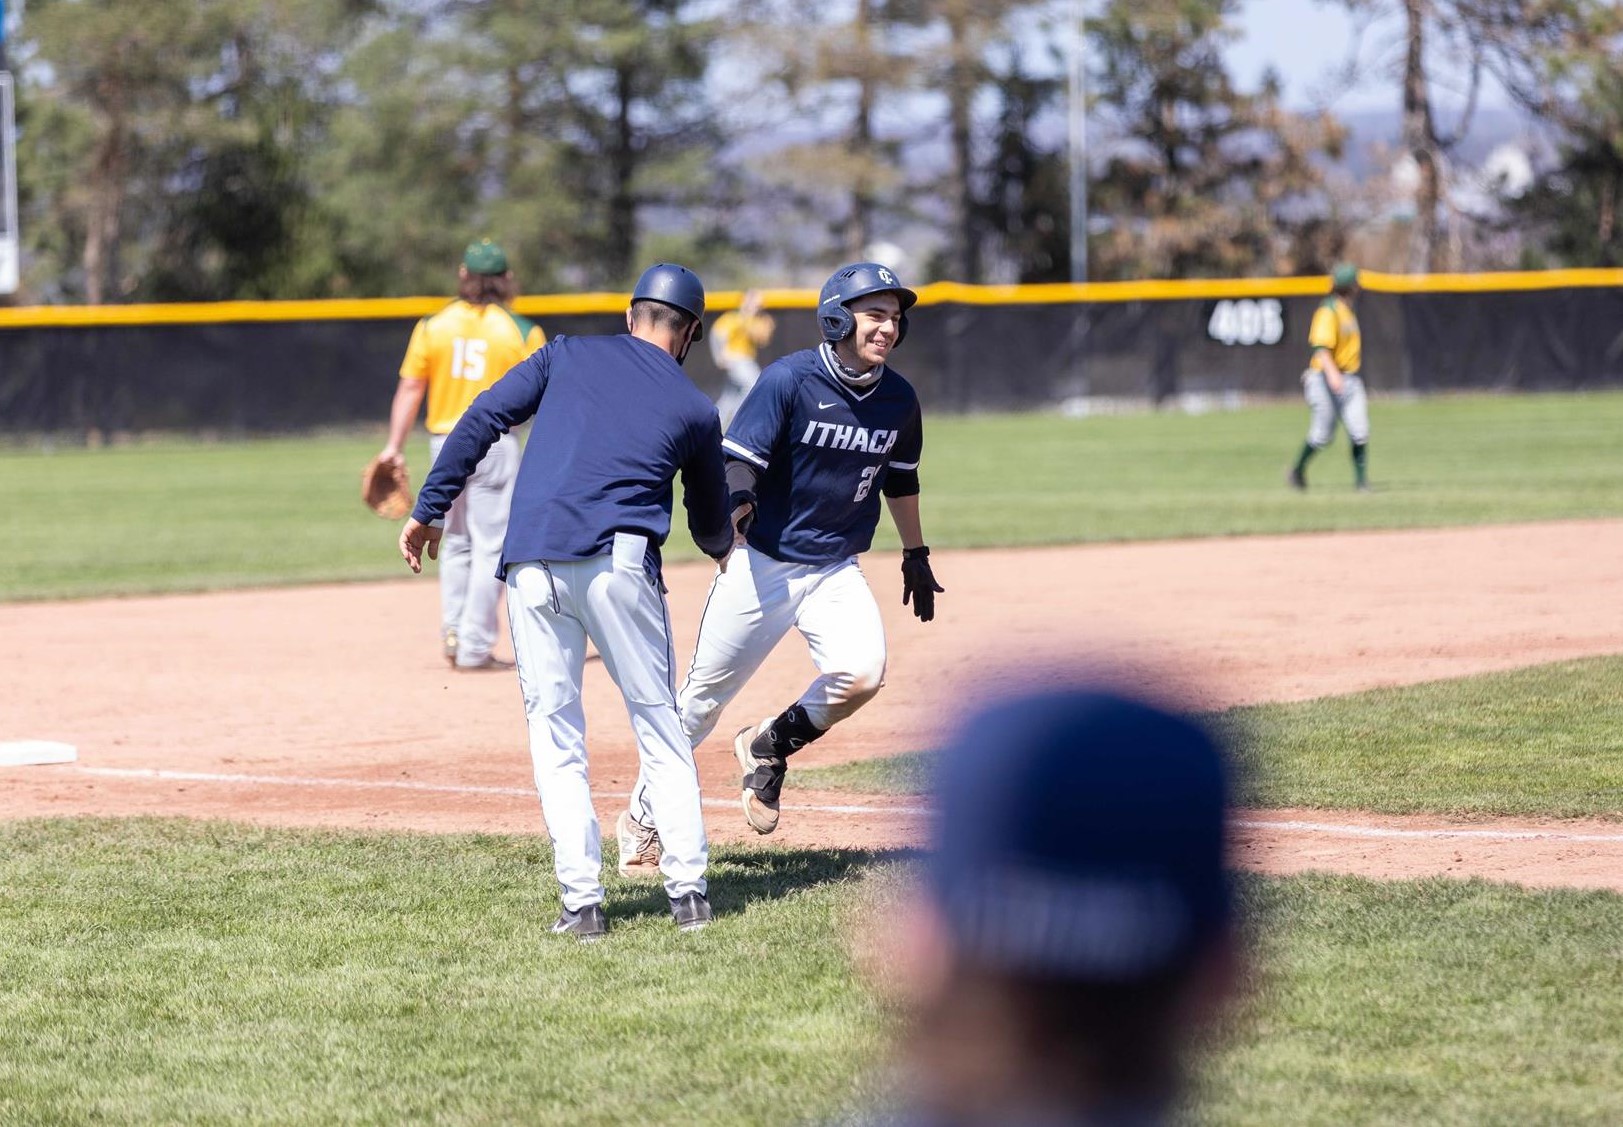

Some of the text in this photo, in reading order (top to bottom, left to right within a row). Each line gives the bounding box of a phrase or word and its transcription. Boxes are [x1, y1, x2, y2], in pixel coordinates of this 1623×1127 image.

[452, 337, 487, 380] 15
[800, 420, 898, 454] ITHACA
[853, 464, 882, 502] 2
